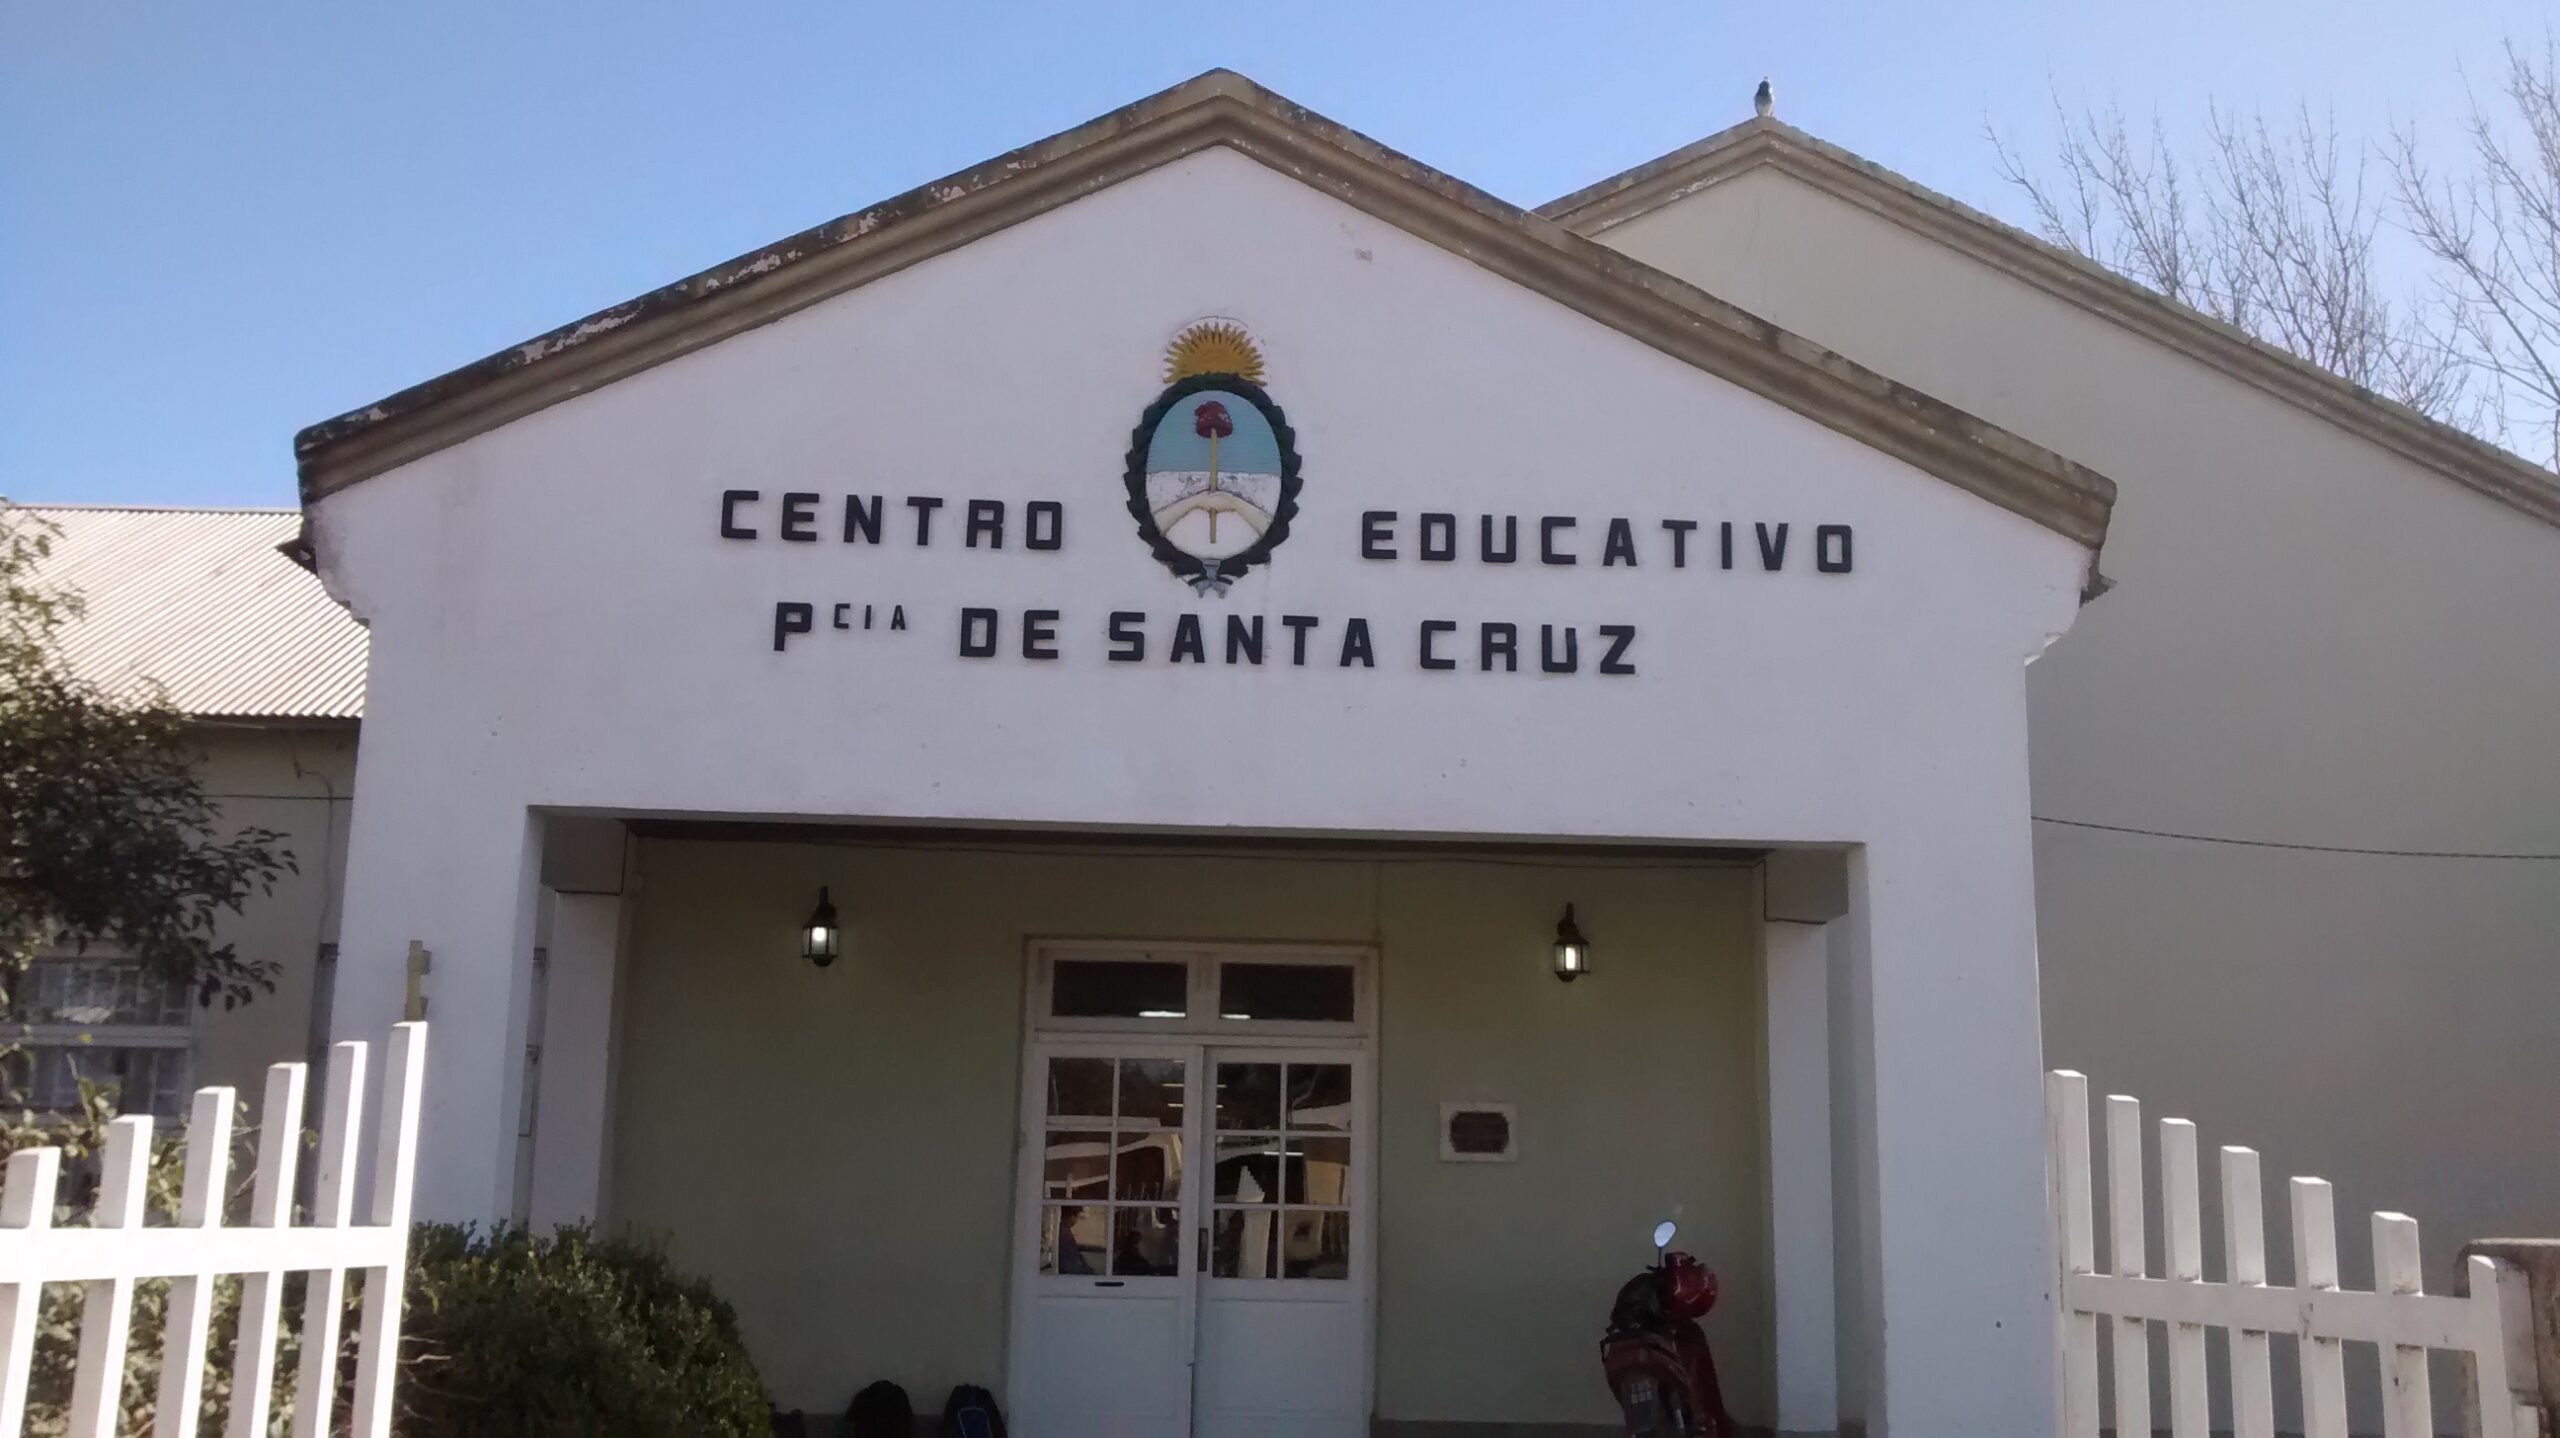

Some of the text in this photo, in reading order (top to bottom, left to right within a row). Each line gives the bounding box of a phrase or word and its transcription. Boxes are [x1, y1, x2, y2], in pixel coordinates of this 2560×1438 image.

[720, 488, 1853, 574] CENTRO EDUCATIVO
[959, 606, 1060, 661] DE
[1108, 610, 1375, 668] SANTA
[1419, 619, 1636, 675] CRUZ
